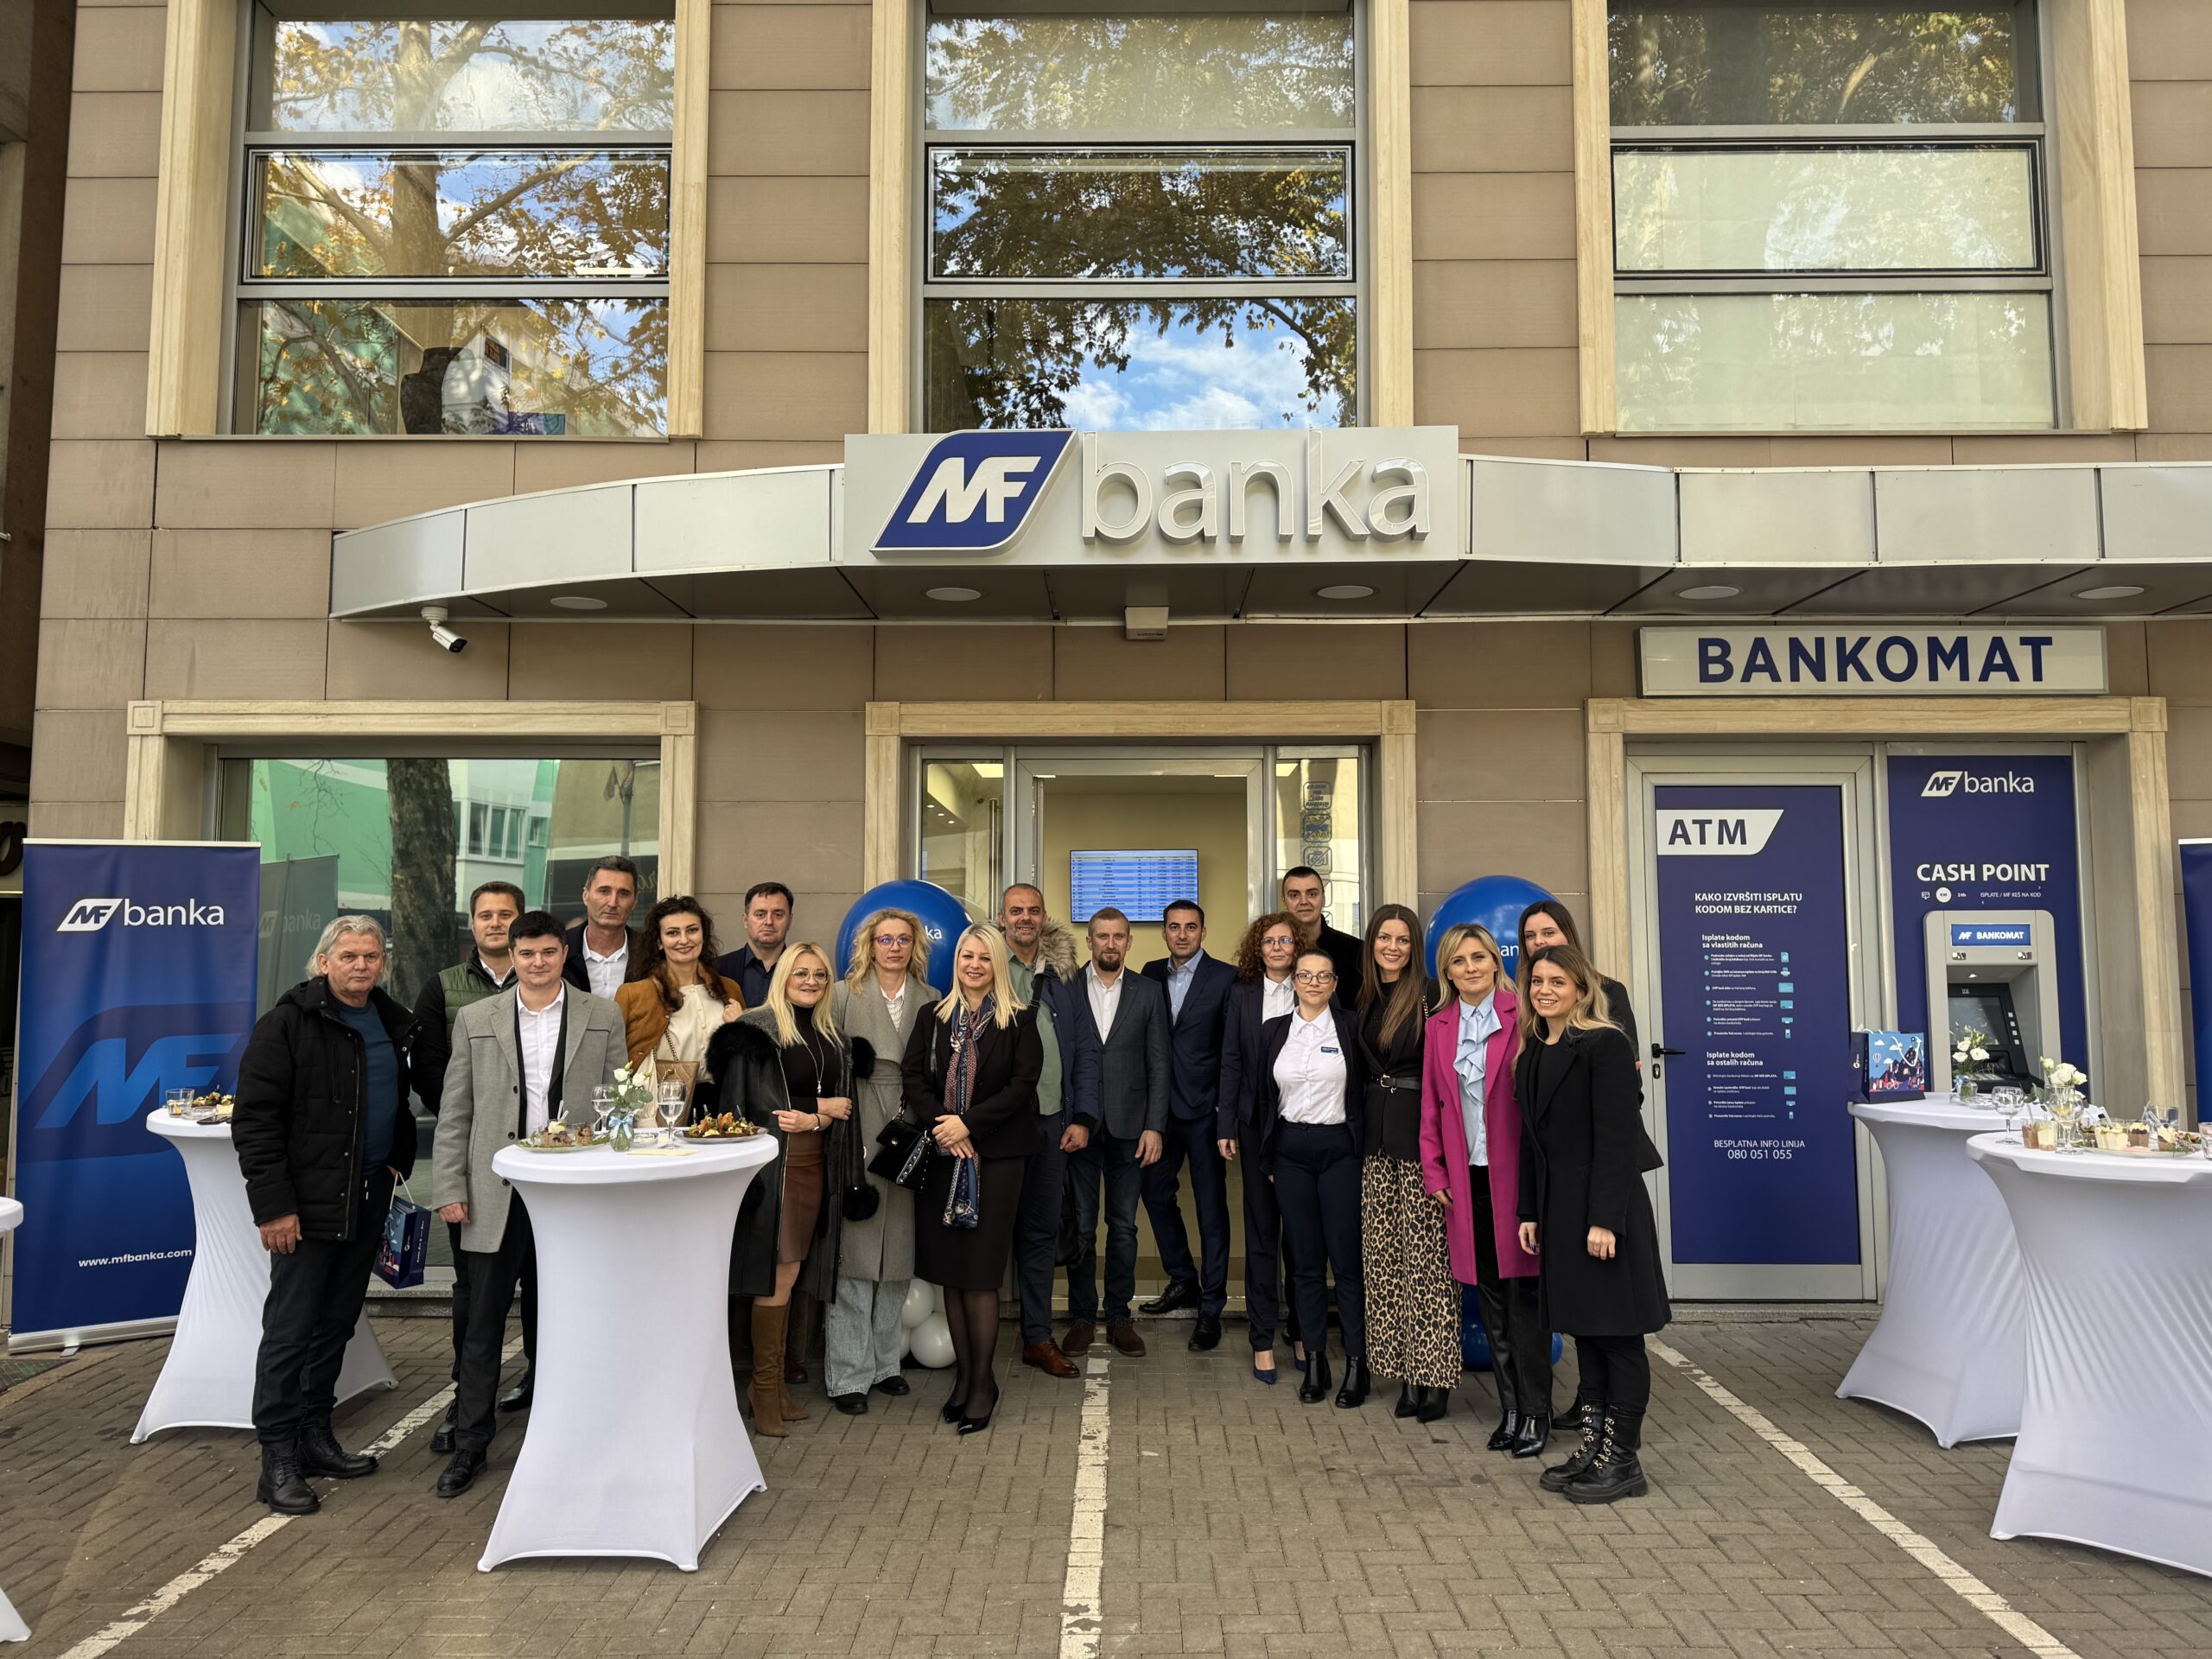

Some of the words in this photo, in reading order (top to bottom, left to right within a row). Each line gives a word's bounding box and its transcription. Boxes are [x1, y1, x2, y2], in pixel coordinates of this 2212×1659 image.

[906, 455, 1041, 524] MF
[1082, 428, 1431, 545] banka
[1697, 635, 2054, 683] BANKOMAT
[1928, 776, 1956, 791] MF
[1964, 771, 2035, 793] banka
[1668, 818, 1748, 845] ATM
[1916, 863, 1976, 881] CASH
[1982, 863, 2050, 881] POINT
[1694, 893, 1722, 901] KAKO
[1723, 891, 1762, 901] IZVRŠITI
[1764, 893, 1802, 901] ISPLATU
[67, 905, 113, 925] MF
[124, 898, 225, 926] banka
[1695, 905, 1732, 914] KODOM
[1734, 905, 1752, 914] BEZ
[1753, 905, 1797, 914] KARTICE?
[1976, 931, 2024, 940] BANKOMAT
[1707, 1051, 1730, 1059] Isplate
[1713, 1140, 1758, 1148] BESPLATNA
[1760, 1140, 1780, 1148] INFO
[1782, 1140, 1806, 1148] LINIJA
[1727, 1149, 1747, 1160] 080
[1750, 1149, 1769, 1160] 051
[1772, 1149, 1792, 1160] 055
[78, 1248, 193, 1268] www.mfbanka.com
